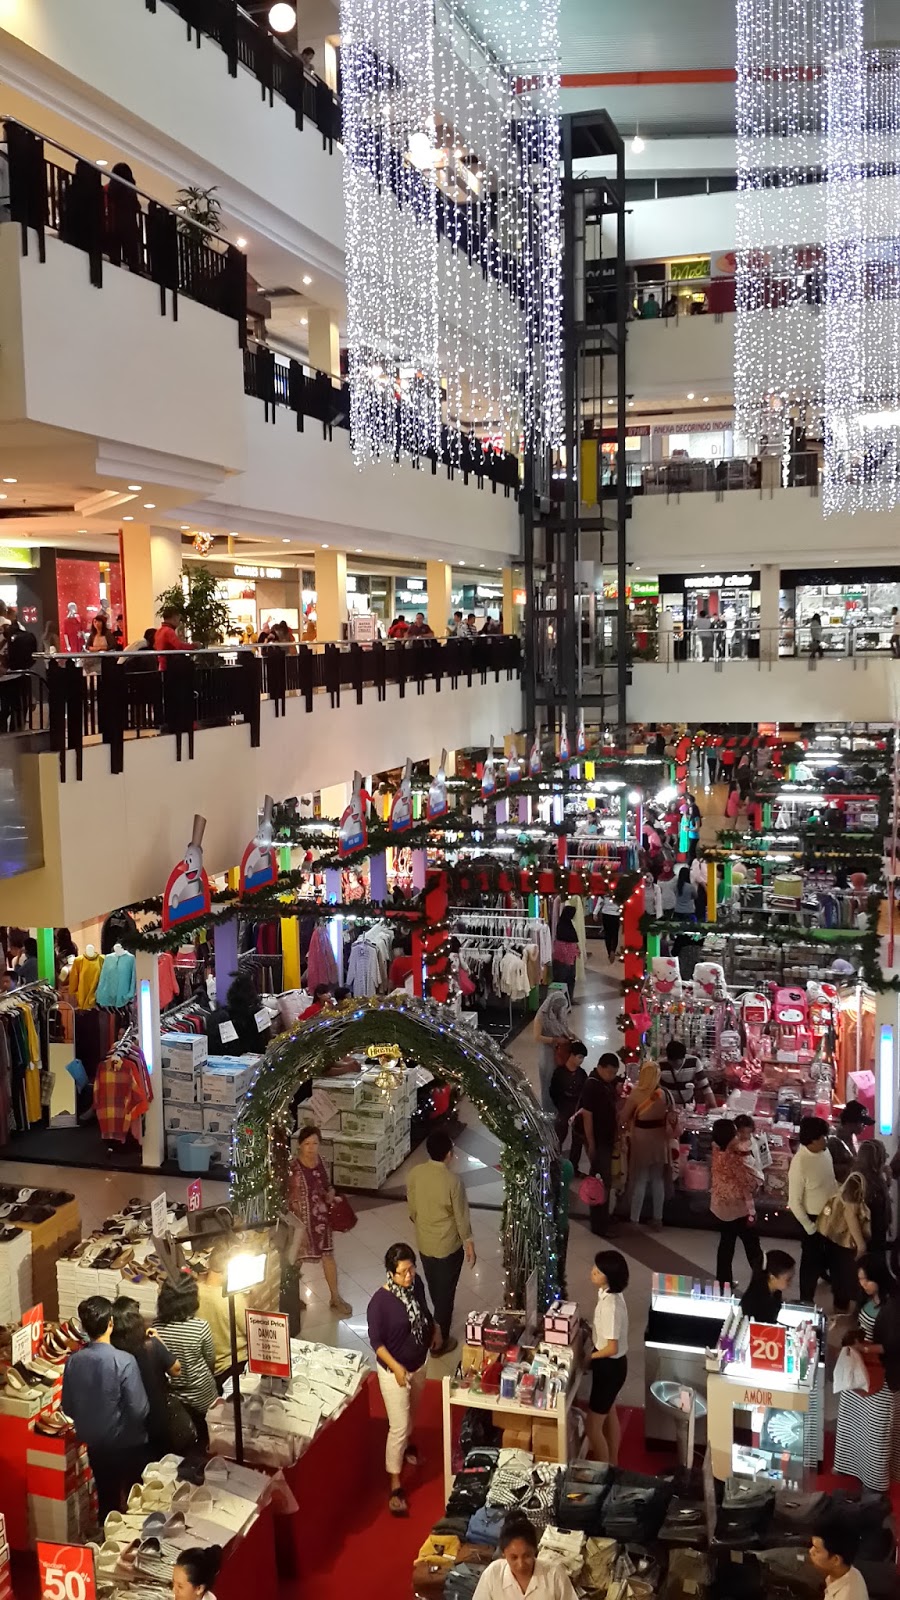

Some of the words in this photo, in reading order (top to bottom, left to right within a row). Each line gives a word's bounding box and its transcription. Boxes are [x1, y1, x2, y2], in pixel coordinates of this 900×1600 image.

[653, 425, 675, 434] ANEKA
[249, 1317, 270, 1326] Special
[270, 1320, 285, 1328] Price
[257, 1328, 277, 1340] DAMON
